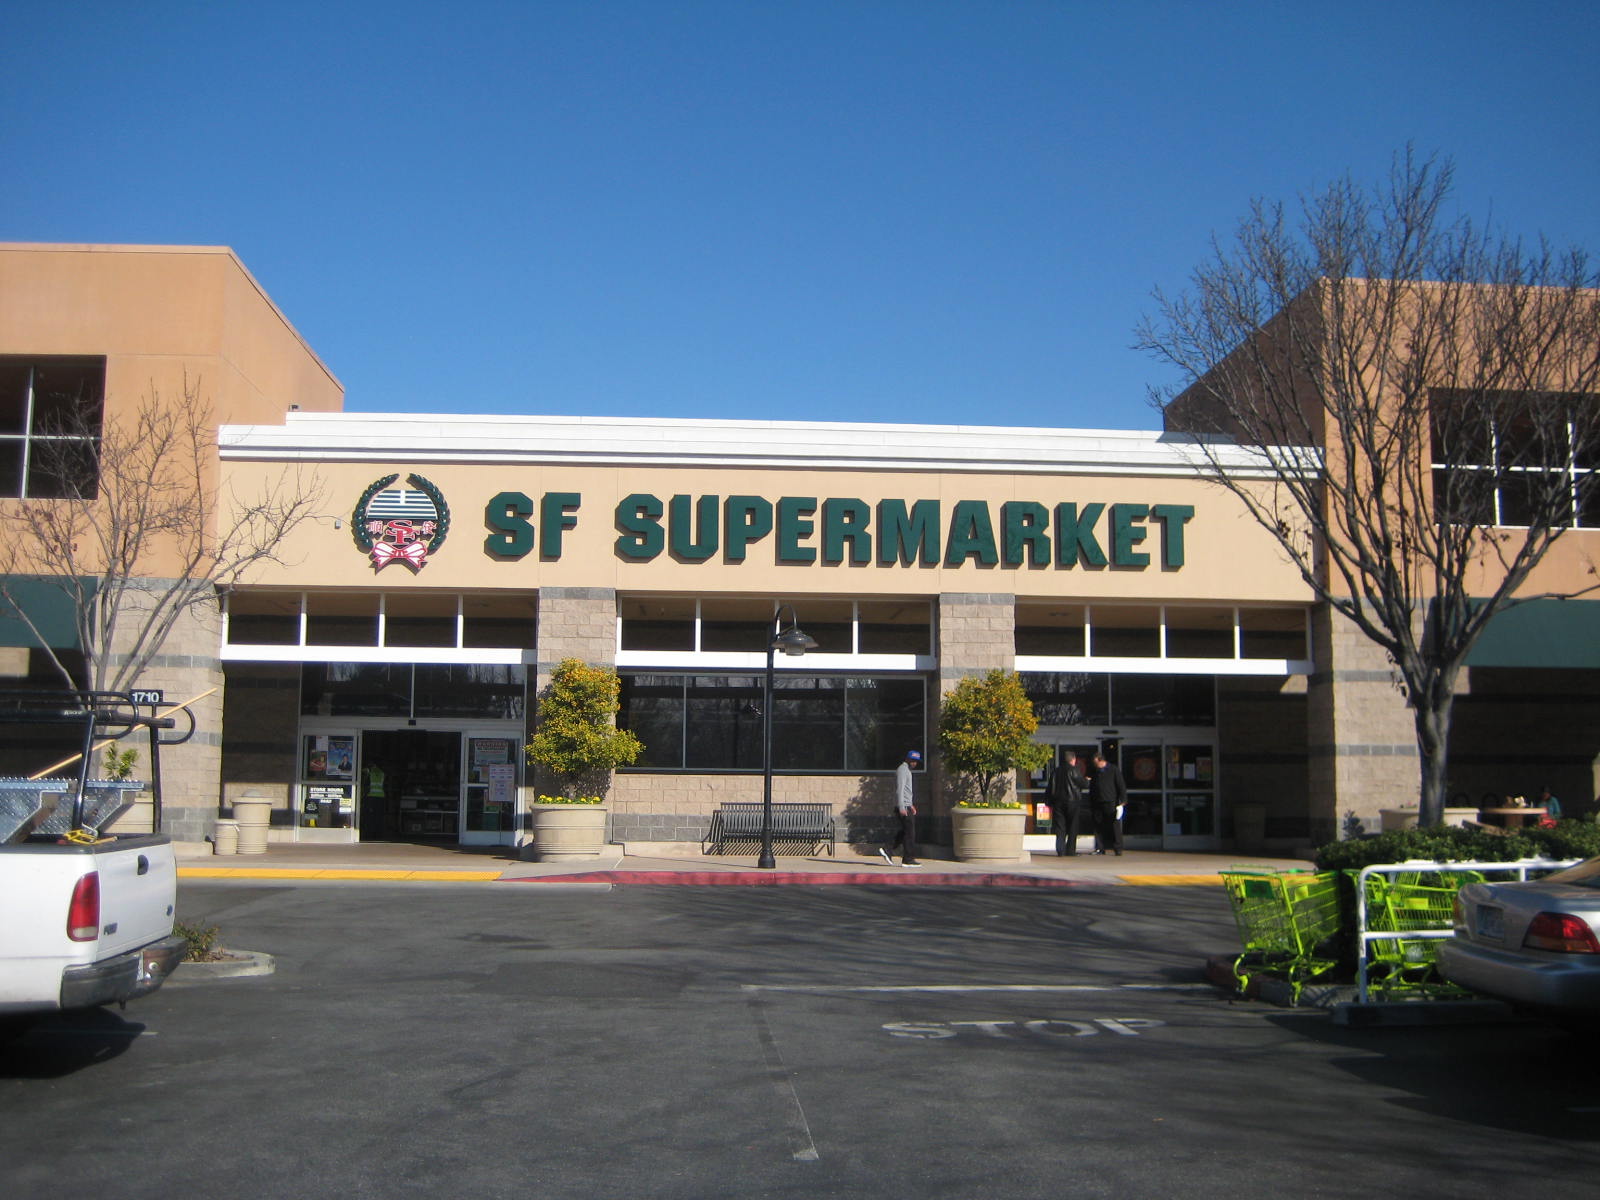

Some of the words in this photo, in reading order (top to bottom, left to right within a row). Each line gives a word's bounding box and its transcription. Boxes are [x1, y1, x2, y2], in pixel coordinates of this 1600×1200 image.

[484, 491, 581, 562] SF
[614, 494, 1195, 572] SUPERMARKET
[131, 691, 160, 703] 1710
[881, 1017, 1167, 1039] STOP
